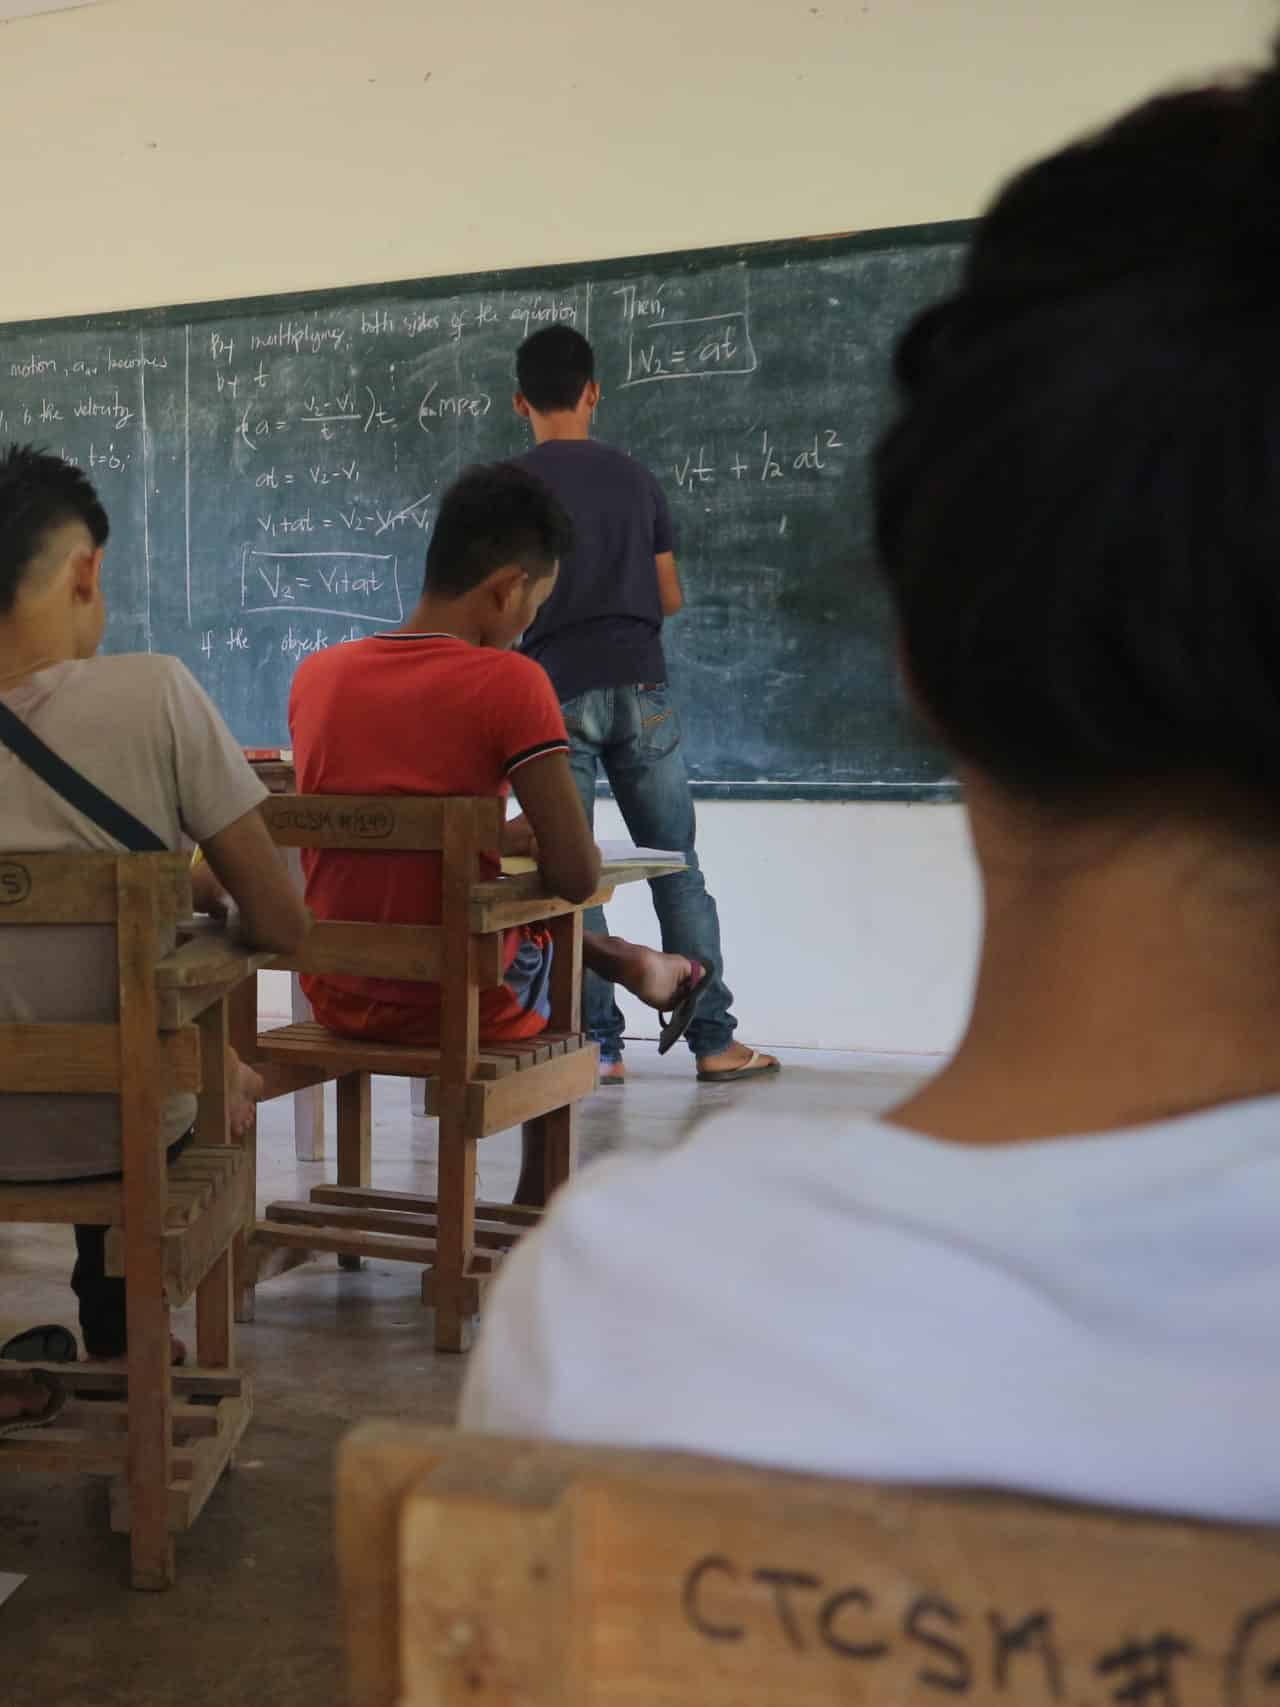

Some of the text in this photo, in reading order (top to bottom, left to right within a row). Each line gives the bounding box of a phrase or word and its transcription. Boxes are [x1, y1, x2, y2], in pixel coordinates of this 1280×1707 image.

[361, 310, 394, 337] both
[451, 309, 469, 343] of
[478, 301, 500, 328] the
[108, 348, 169, 372] becomes
[699, 325, 737, 361] at
[216, 359, 271, 400] by t
[20, 402, 32, 426] is
[39, 397, 65, 424] the
[73, 390, 134, 430] velocity
[320, 423, 336, 441] t
[255, 466, 279, 489] at
[225, 626, 250, 651] the
[682, 1552, 1066, 1698] CTCSM
